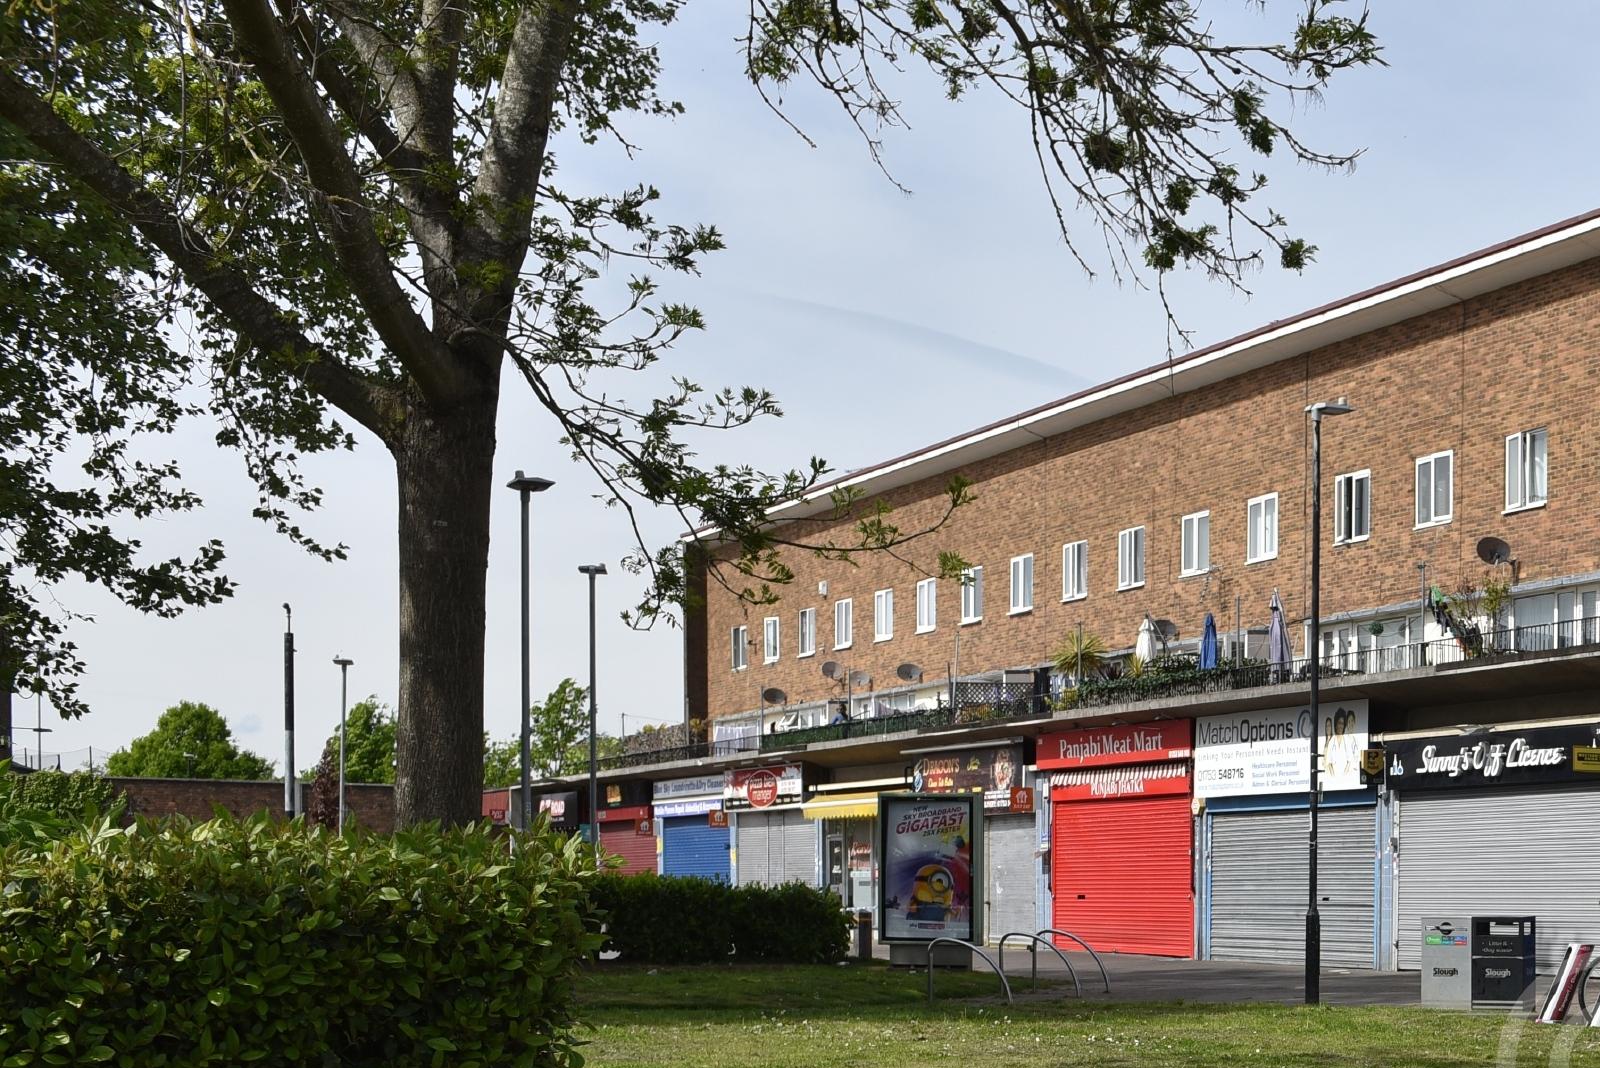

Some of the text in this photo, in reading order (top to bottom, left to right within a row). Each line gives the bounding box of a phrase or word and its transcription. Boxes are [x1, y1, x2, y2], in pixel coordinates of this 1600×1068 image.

[1198, 717, 1294, 749] MatchOptions
[1059, 730, 1163, 763] Panjabi Meat Mart
[1415, 744, 1473, 778] Sunny's
[1471, 741, 1507, 778] Off
[1505, 737, 1567, 768] Licence
[1218, 767, 1244, 780] 548716
[918, 806, 962, 818] BROADBAND
[896, 812, 967, 834] GIGAFAST
[936, 825, 961, 834] FASTER
[1433, 967, 1459, 977] Slough
[1484, 967, 1512, 978] Slough
